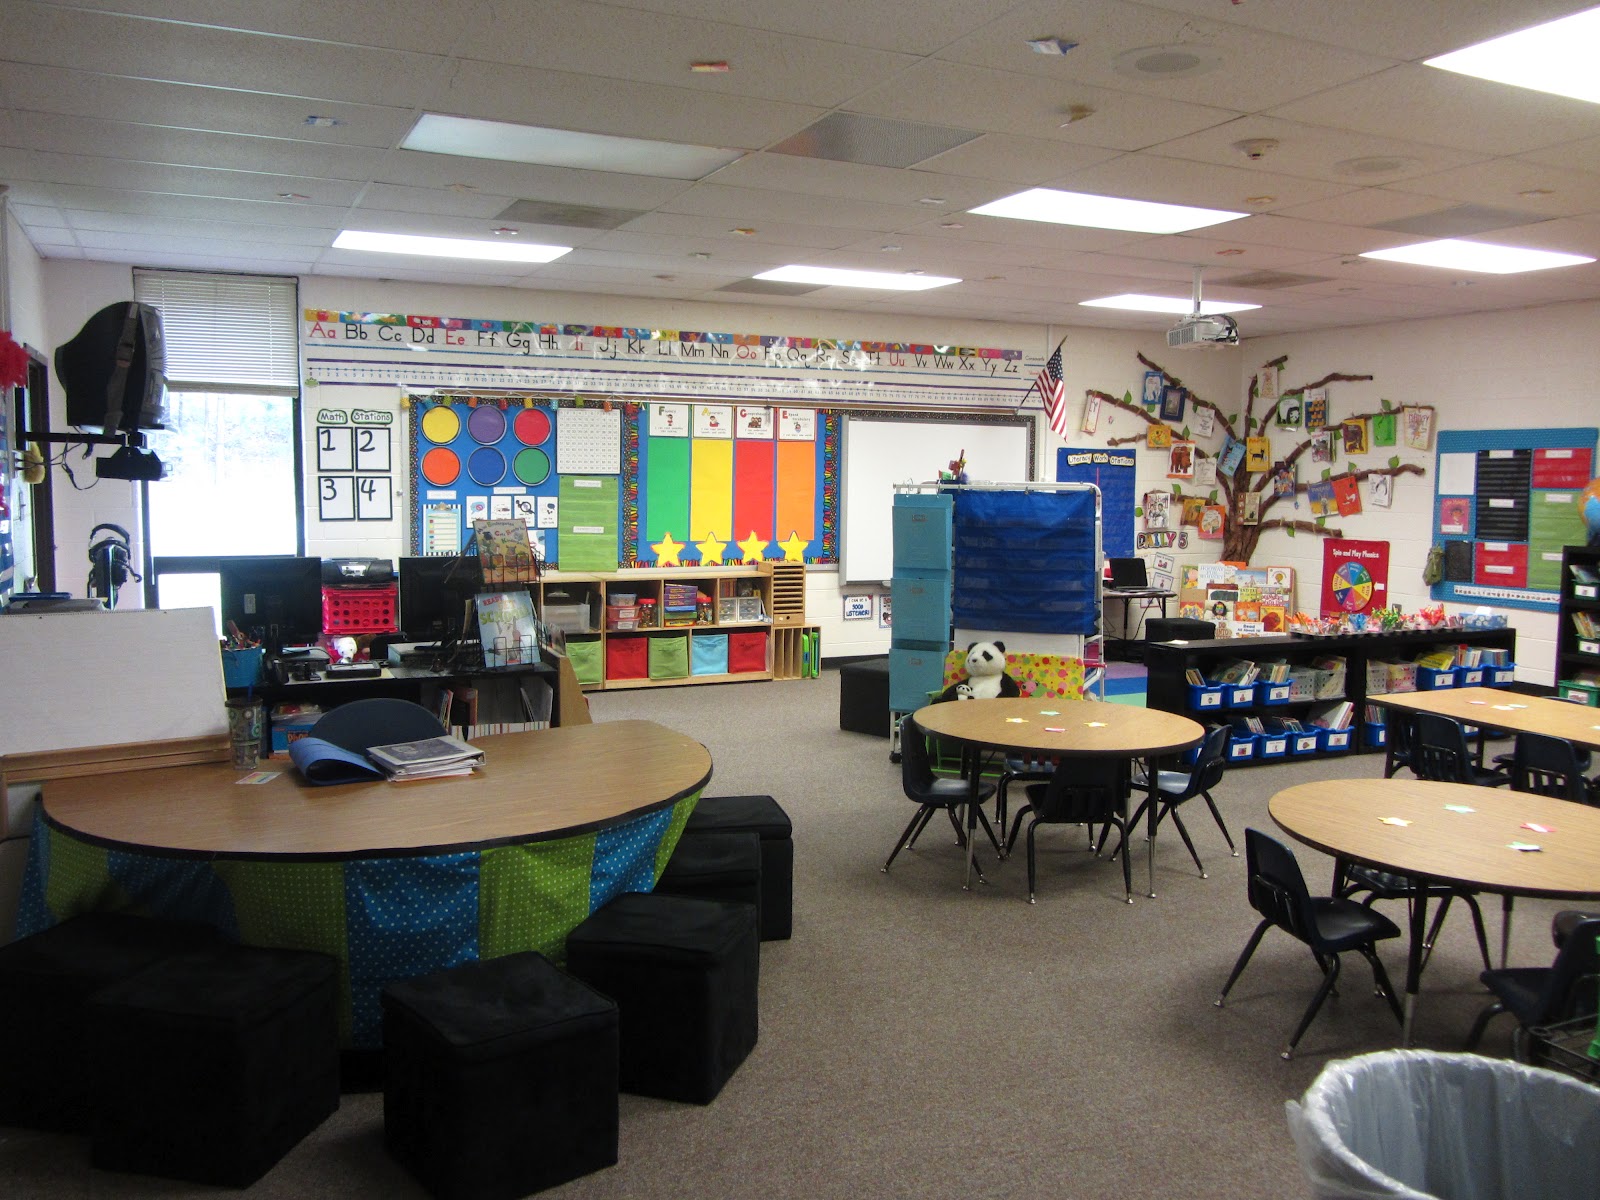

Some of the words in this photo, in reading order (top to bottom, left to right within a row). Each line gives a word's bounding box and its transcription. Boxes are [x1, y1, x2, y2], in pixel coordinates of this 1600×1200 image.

[309, 322, 336, 338] Aa
[345, 323, 368, 340] Bb
[378, 325, 402, 342] Cc
[412, 327, 434, 344] Dd
[446, 329, 465, 345] Ee
[477, 331, 498, 347] Ff
[506, 332, 530, 355] Gg
[538, 334, 559, 350] Hh
[575, 335, 583, 351] Ii
[599, 337, 617, 359] Jj
[628, 338, 645, 354] Kk
[658, 340, 671, 356] Ll
[681, 342, 705, 358] Mm
[711, 343, 729, 358] Nn
[736, 344, 756, 359] Oo
[787, 347, 810, 368] Qq
[866, 351, 880, 365] Tt
[889, 352, 905, 366] Uu
[915, 354, 927, 368] Vv
[933, 355, 954, 369] Ww
[959, 357, 974, 370] Xx
[982, 358, 997, 377] Yy
[1004, 360, 1018, 372] Zz
[320, 413, 345, 421] Math
[354, 412, 390, 421] Stations
[320, 429, 336, 451] 1
[359, 430, 376, 452] 2
[1068, 455, 1090, 463] Literacy
[323, 478, 337, 501] 3
[360, 479, 376, 502] 4
[1137, 531, 1177, 549] DAILY
[1178, 531, 1188, 550] 5
[1333, 548, 1342, 557] Spin
[1352, 550, 1362, 559] Play
[1362, 550, 1379, 558] Phonics
